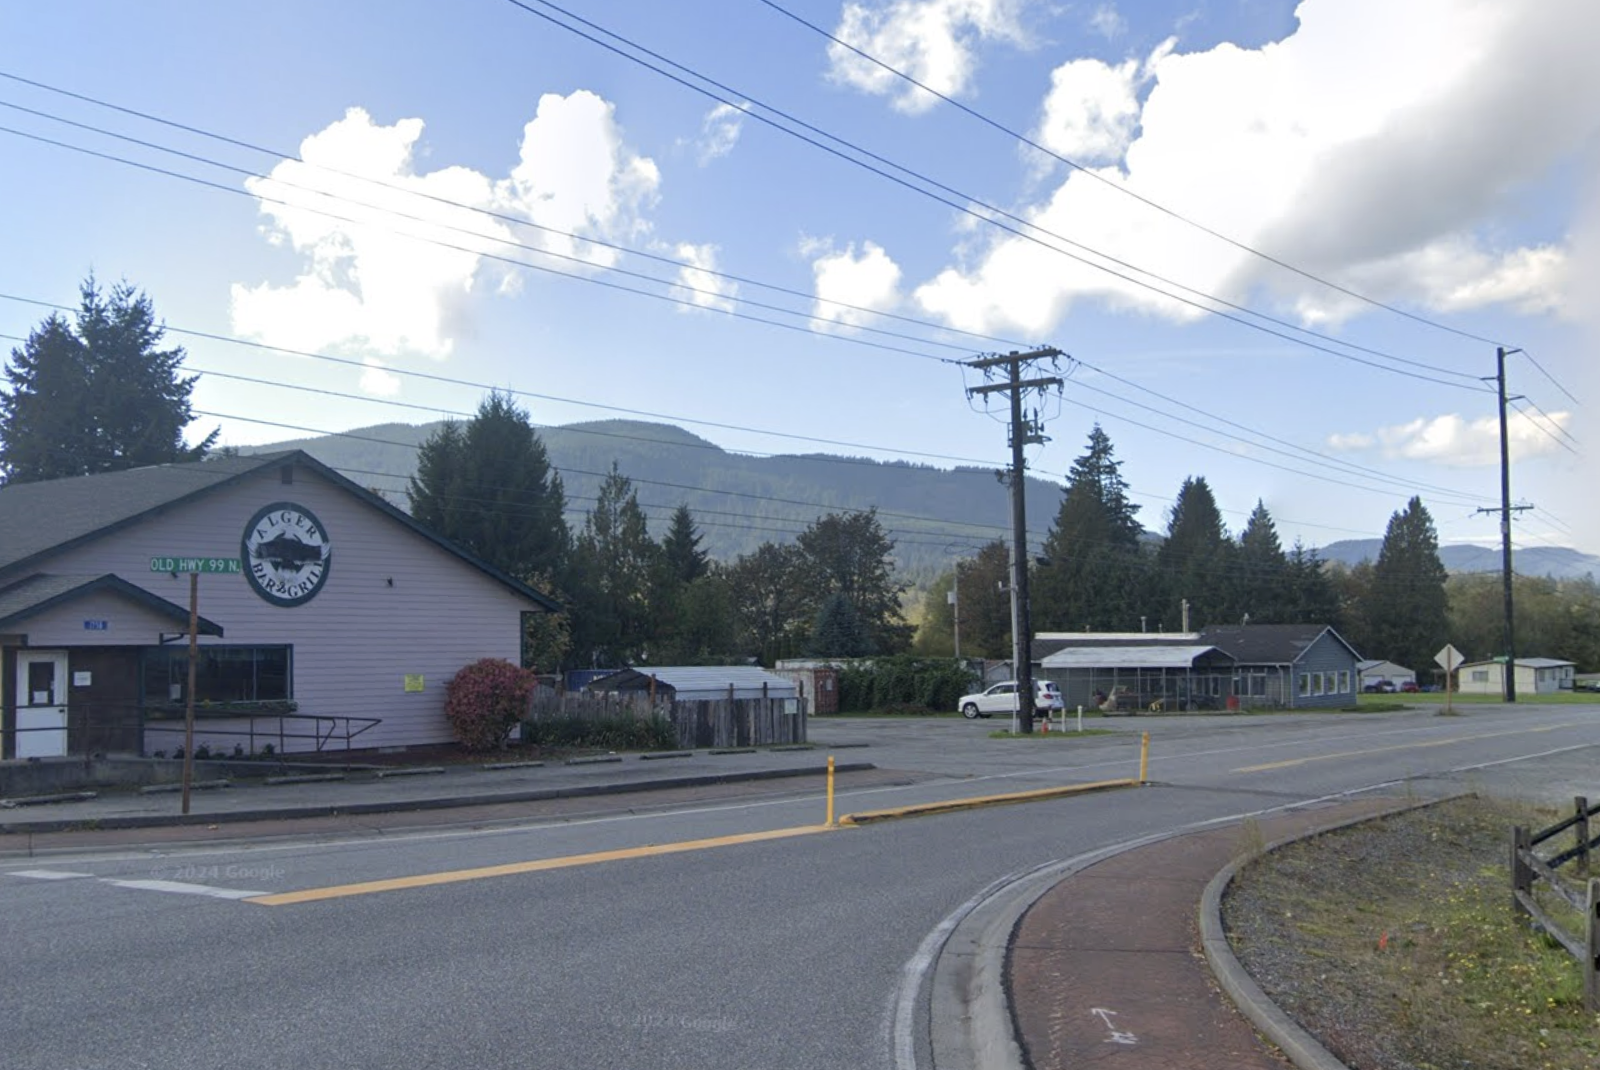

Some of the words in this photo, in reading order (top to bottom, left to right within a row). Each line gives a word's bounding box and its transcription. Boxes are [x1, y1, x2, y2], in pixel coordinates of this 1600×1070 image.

[256, 511, 317, 540] ALGER
[150, 558, 174, 571] OLD
[179, 558, 205, 572] HWY
[209, 559, 225, 571] 99
[229, 560, 240, 572] N.
[252, 562, 276, 592] BAR
[276, 582, 286, 594] &
[288, 560, 323, 597] GRILL
